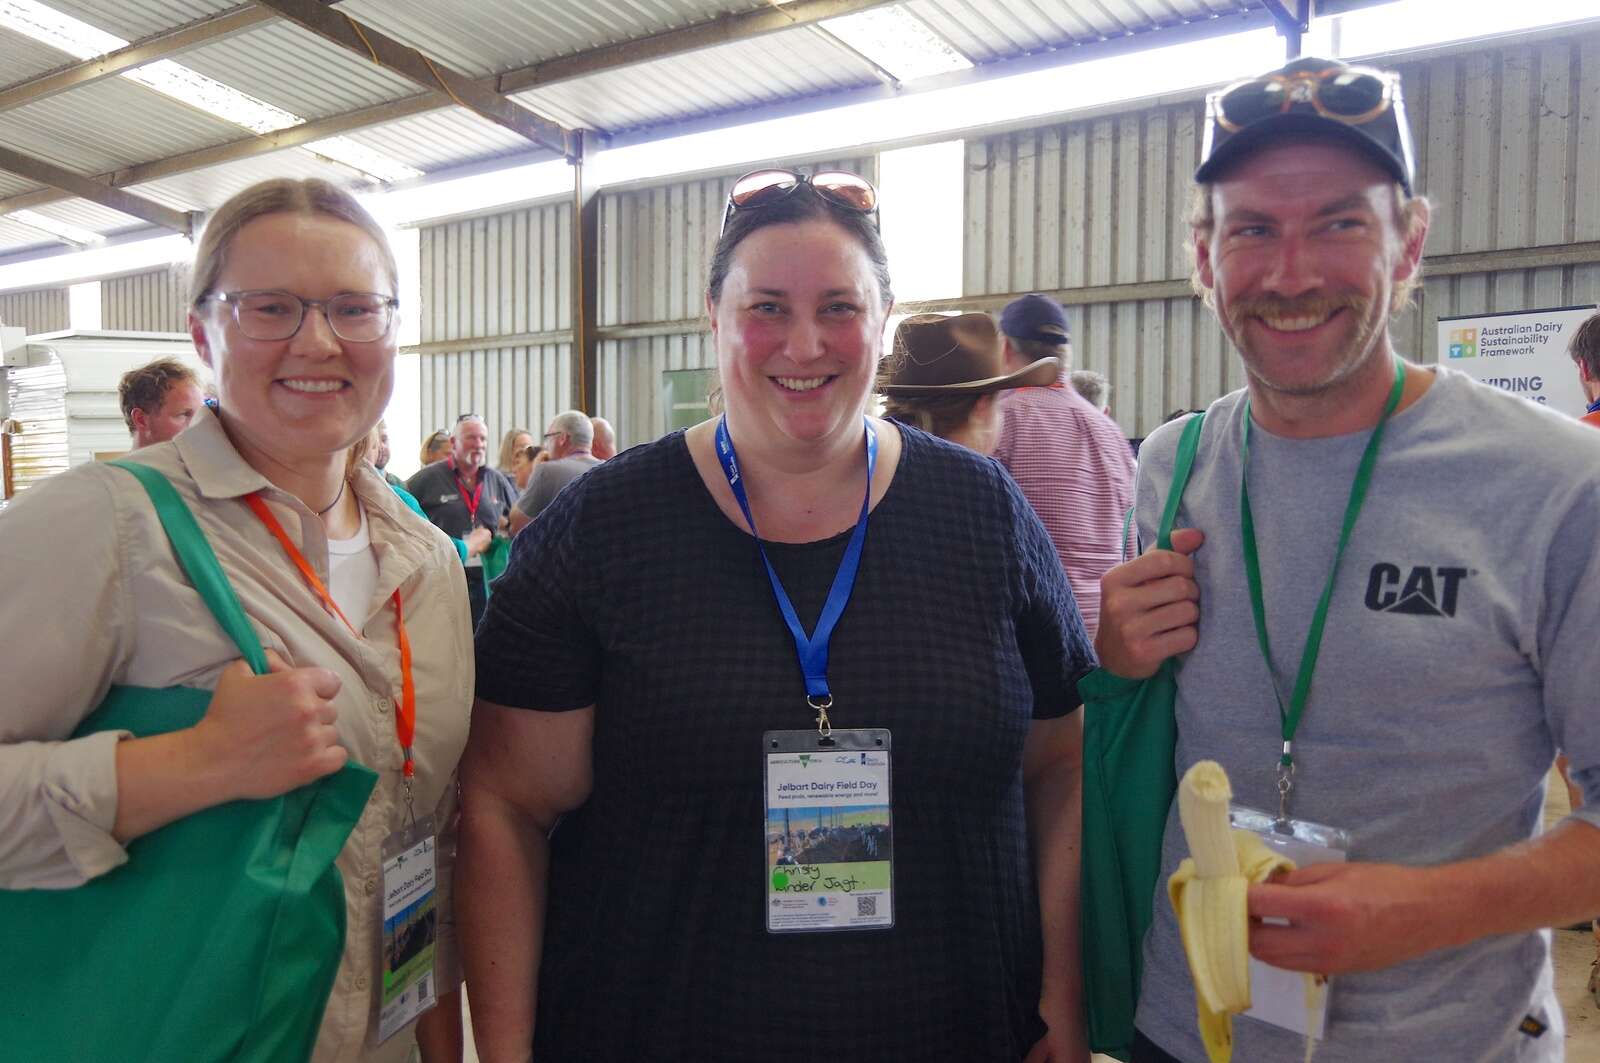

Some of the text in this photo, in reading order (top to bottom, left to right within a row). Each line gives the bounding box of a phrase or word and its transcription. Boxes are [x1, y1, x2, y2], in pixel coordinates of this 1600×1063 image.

[1481, 321, 1563, 336] Australian Dairy
[1480, 334, 1549, 347] Sustainability
[1480, 345, 1535, 357] Framework
[1364, 562, 1468, 618] CAT
[777, 780, 878, 792] Jelbart Dairy Field Day
[776, 879, 817, 893] nder
